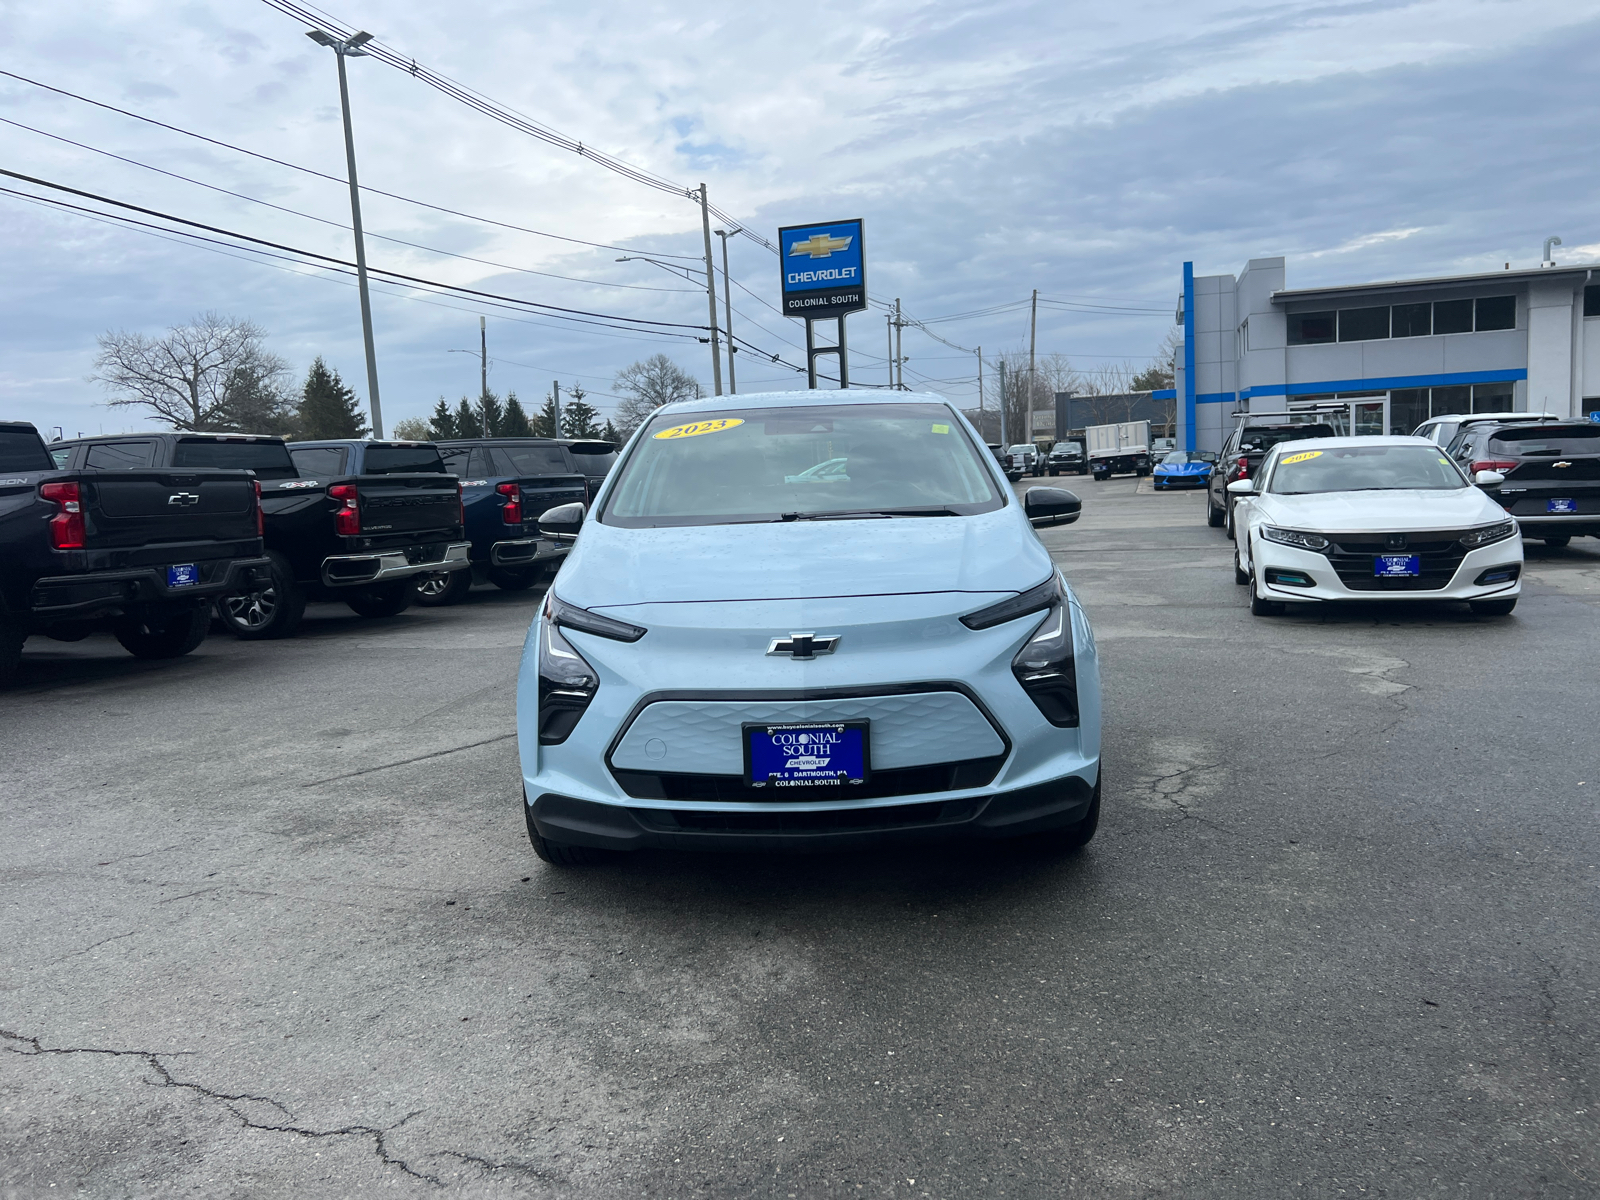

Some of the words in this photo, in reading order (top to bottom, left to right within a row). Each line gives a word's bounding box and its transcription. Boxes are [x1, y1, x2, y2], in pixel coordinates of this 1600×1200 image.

[787, 266, 857, 284] CHEVROLET
[788, 297, 829, 308] COLONIAL
[831, 294, 859, 304] SOUTH
[668, 419, 728, 438] 2023
[1289, 451, 1316, 463] 2018
[771, 732, 842, 746] COLONIAL
[783, 744, 831, 756] SOUTH
[793, 770, 837, 778] DARTMOUTH,
[775, 779, 813, 787] COLONIAL
